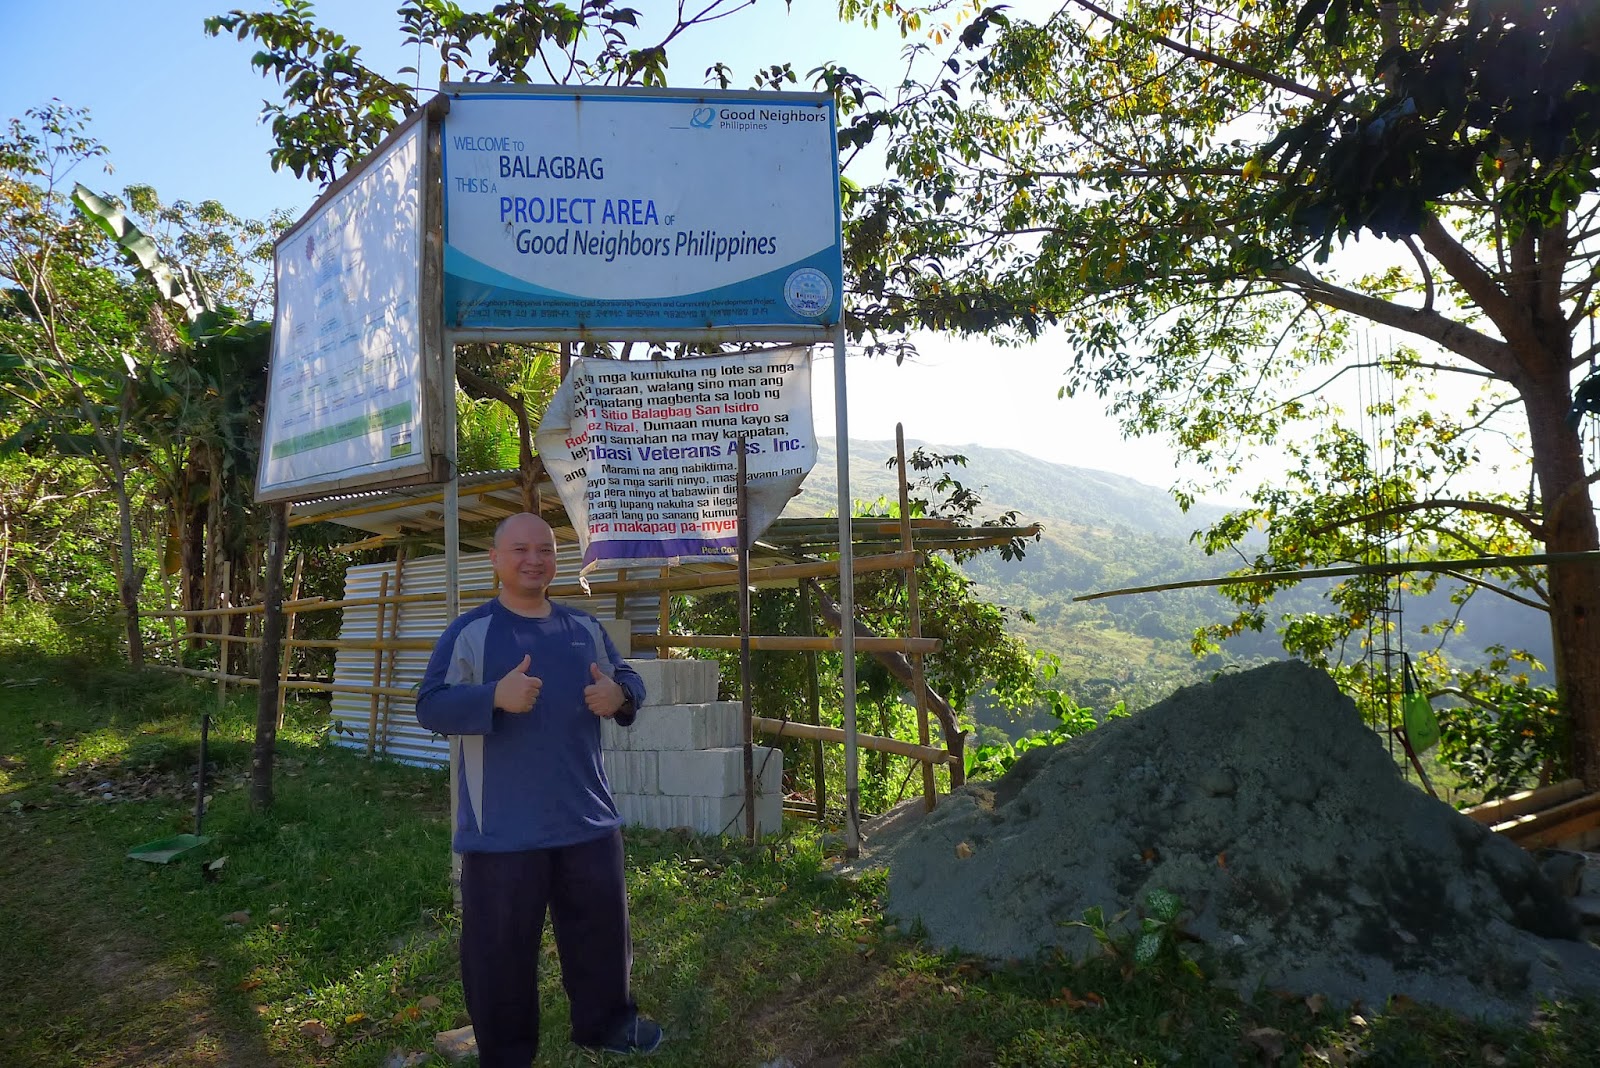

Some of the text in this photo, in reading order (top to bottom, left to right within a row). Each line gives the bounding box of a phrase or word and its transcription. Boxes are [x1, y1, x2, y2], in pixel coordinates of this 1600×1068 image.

[720, 108, 826, 125] Good Neighbors
[720, 121, 768, 131] Philippines
[453, 136, 525, 152] WELCOME TO
[499, 155, 604, 180] BALAGBAG
[455, 177, 497, 193] THIS IS A
[499, 196, 676, 226] PROJECT AREA OF
[516, 228, 777, 262] Good Neighbors Philippines
[599, 373, 627, 385] mga
[631, 368, 697, 381] kumukuha
[701, 368, 717, 378] ng
[721, 365, 744, 376] lote
[748, 365, 762, 374] sa
[767, 363, 794, 374] mga
[595, 385, 643, 396] paraan,
[647, 380, 694, 393] walang
[697, 380, 724, 390] sino
[729, 378, 756, 388] man
[760, 376, 783, 387] ang
[647, 392, 711, 406] magbenta
[714, 392, 729, 401] sa
[733, 389, 760, 400] loob
[764, 389, 780, 399] ng
[601, 409, 628, 420] Sitio
[632, 406, 692, 420] Balagbag
[695, 404, 720, 415] San
[724, 402, 759, 413] Isidro
[586, 422, 602, 431] ez
[605, 421, 639, 433] Rizal,
[643, 420, 697, 431] Dumaan
[702, 418, 737, 428] muna
[741, 414, 770, 426] kayo
[774, 413, 789, 423] sa
[610, 434, 667, 445] samahan
[672, 433, 687, 442] na
[691, 431, 719, 442] may
[723, 426, 789, 440] karapatan,
[637, 444, 721, 461] Veterans
[773, 437, 805, 453] Inc.
[601, 464, 639, 475] Marami
[658, 466, 678, 476] ang
[682, 462, 737, 473] nabiktima.
[623, 479, 645, 488] mga
[648, 476, 673, 487] sarili
[677, 476, 709, 487] ninyo,
[604, 488, 626, 498] pera
[629, 489, 656, 499] ninyo
[659, 489, 669, 497] at
[671, 486, 719, 497] babawiin
[597, 500, 617, 510] ang
[620, 499, 654, 510] lupang
[656, 498, 694, 509] nakuha
[697, 499, 709, 507] sa
[712, 496, 738, 507] ilega
[621, 510, 644, 521] lang
[646, 512, 659, 521] po
[662, 511, 699, 520] sanang
[614, 520, 676, 535] makapag
